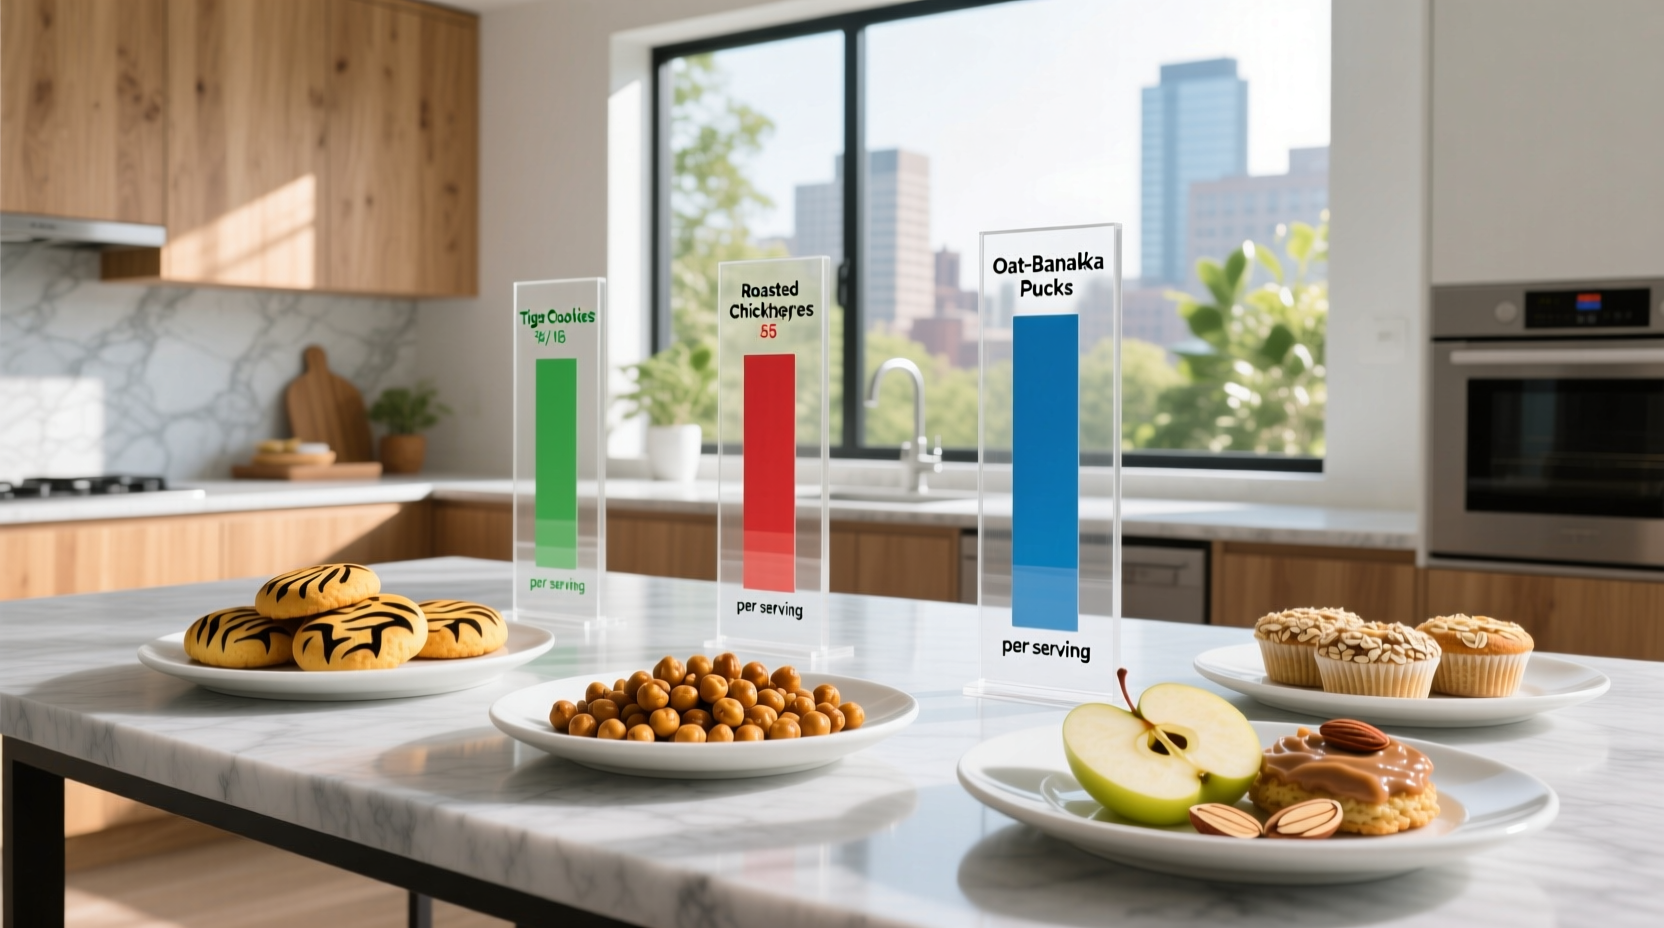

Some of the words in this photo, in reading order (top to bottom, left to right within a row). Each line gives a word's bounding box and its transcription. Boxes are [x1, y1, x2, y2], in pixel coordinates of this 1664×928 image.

[741, 280, 799, 298] Roasted
[1020, 278, 1073, 297] Pucks
[530, 578, 547, 591] per
[737, 601, 757, 615] per
[759, 601, 803, 620] serving
[1002, 640, 1030, 656] per
[1032, 640, 1091, 663] serving
